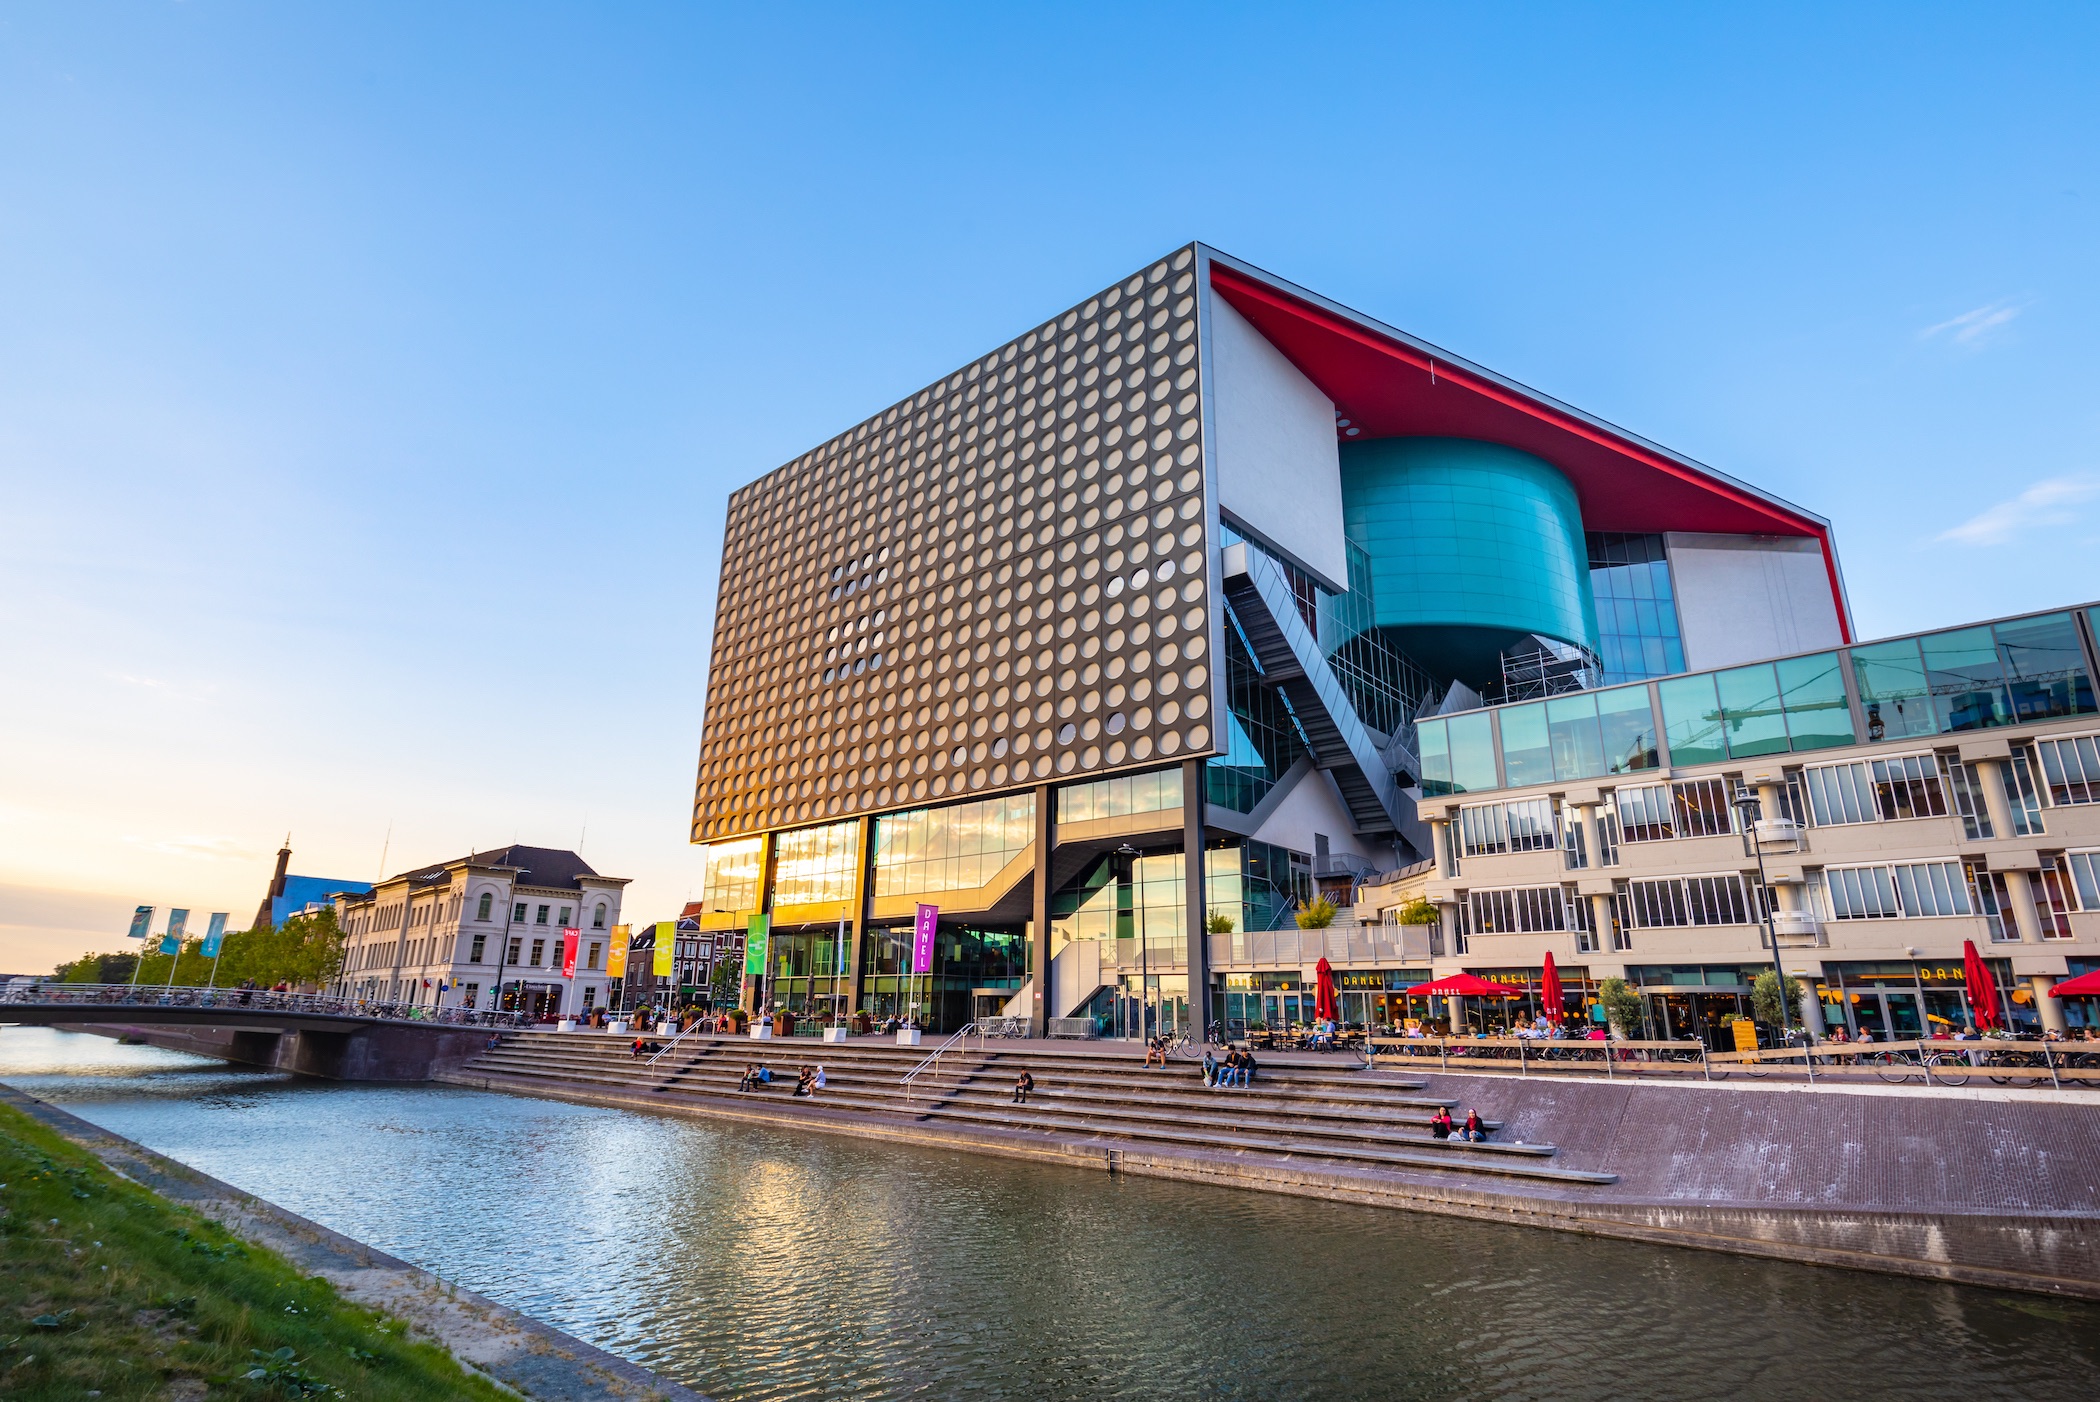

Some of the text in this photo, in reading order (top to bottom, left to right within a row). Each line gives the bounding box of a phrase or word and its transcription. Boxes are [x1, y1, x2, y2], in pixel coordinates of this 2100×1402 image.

[920, 909, 931, 967] DANEL
[1481, 974, 1526, 984] DANEL
[1921, 968, 1964, 980] DAN
[1228, 977, 1260, 987] DANEL
[1343, 976, 1383, 986] DANEL
